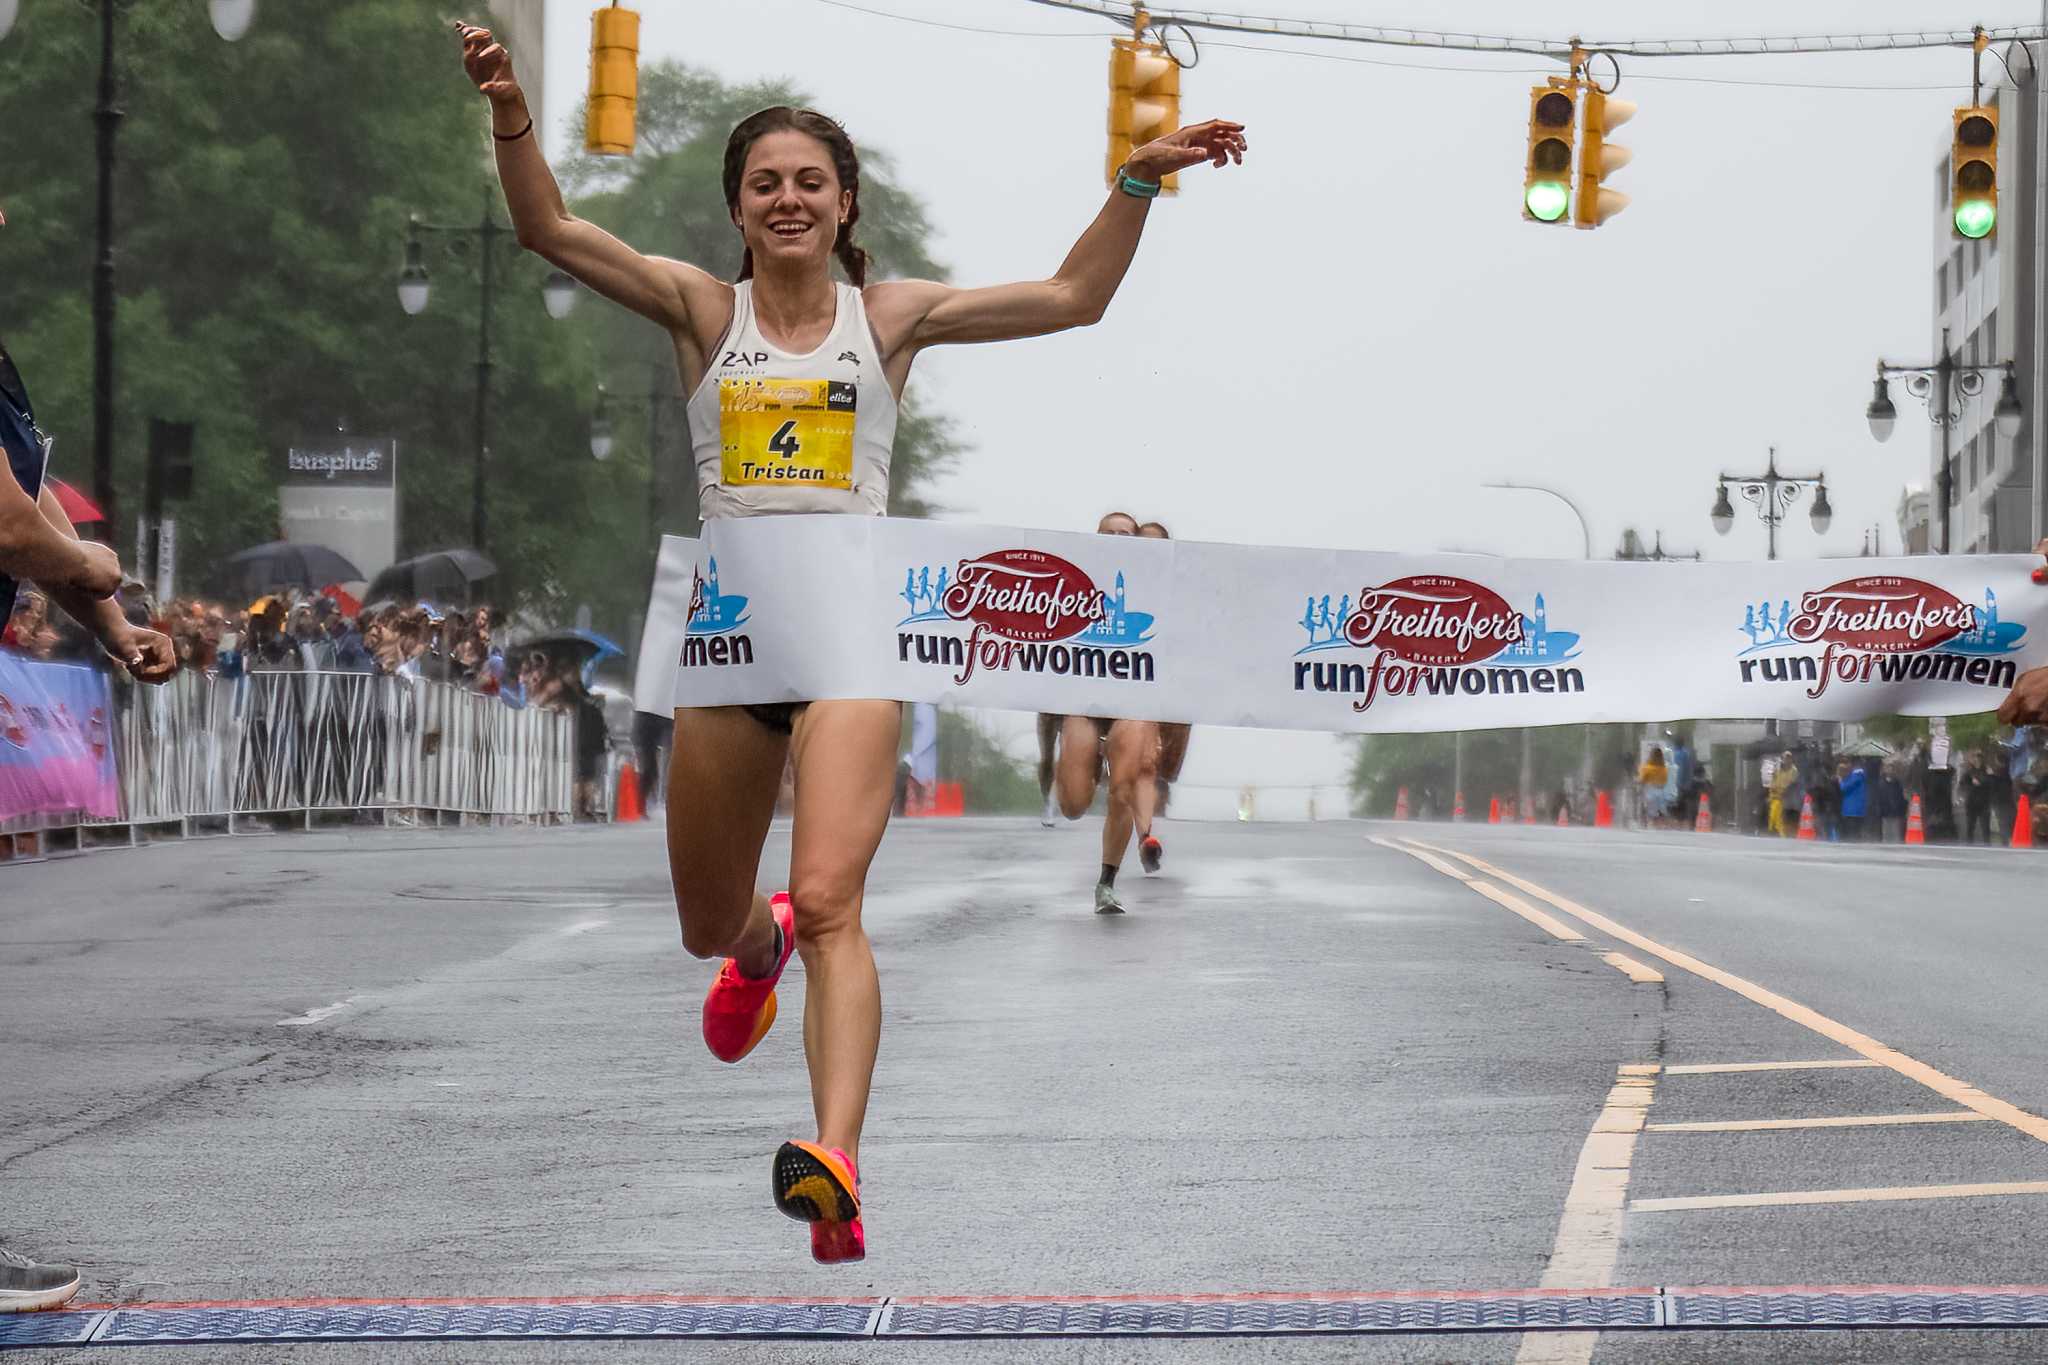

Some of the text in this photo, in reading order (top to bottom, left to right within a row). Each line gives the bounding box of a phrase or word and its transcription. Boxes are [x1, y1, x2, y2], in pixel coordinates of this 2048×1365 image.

[721, 351, 769, 367] ZAP
[768, 420, 800, 459] 4
[741, 462, 825, 480] Tristan
[943, 561, 1104, 629] Freihofer's
[1788, 592, 1975, 638] Freihofer's
[1345, 588, 1523, 653] Freihofer's
